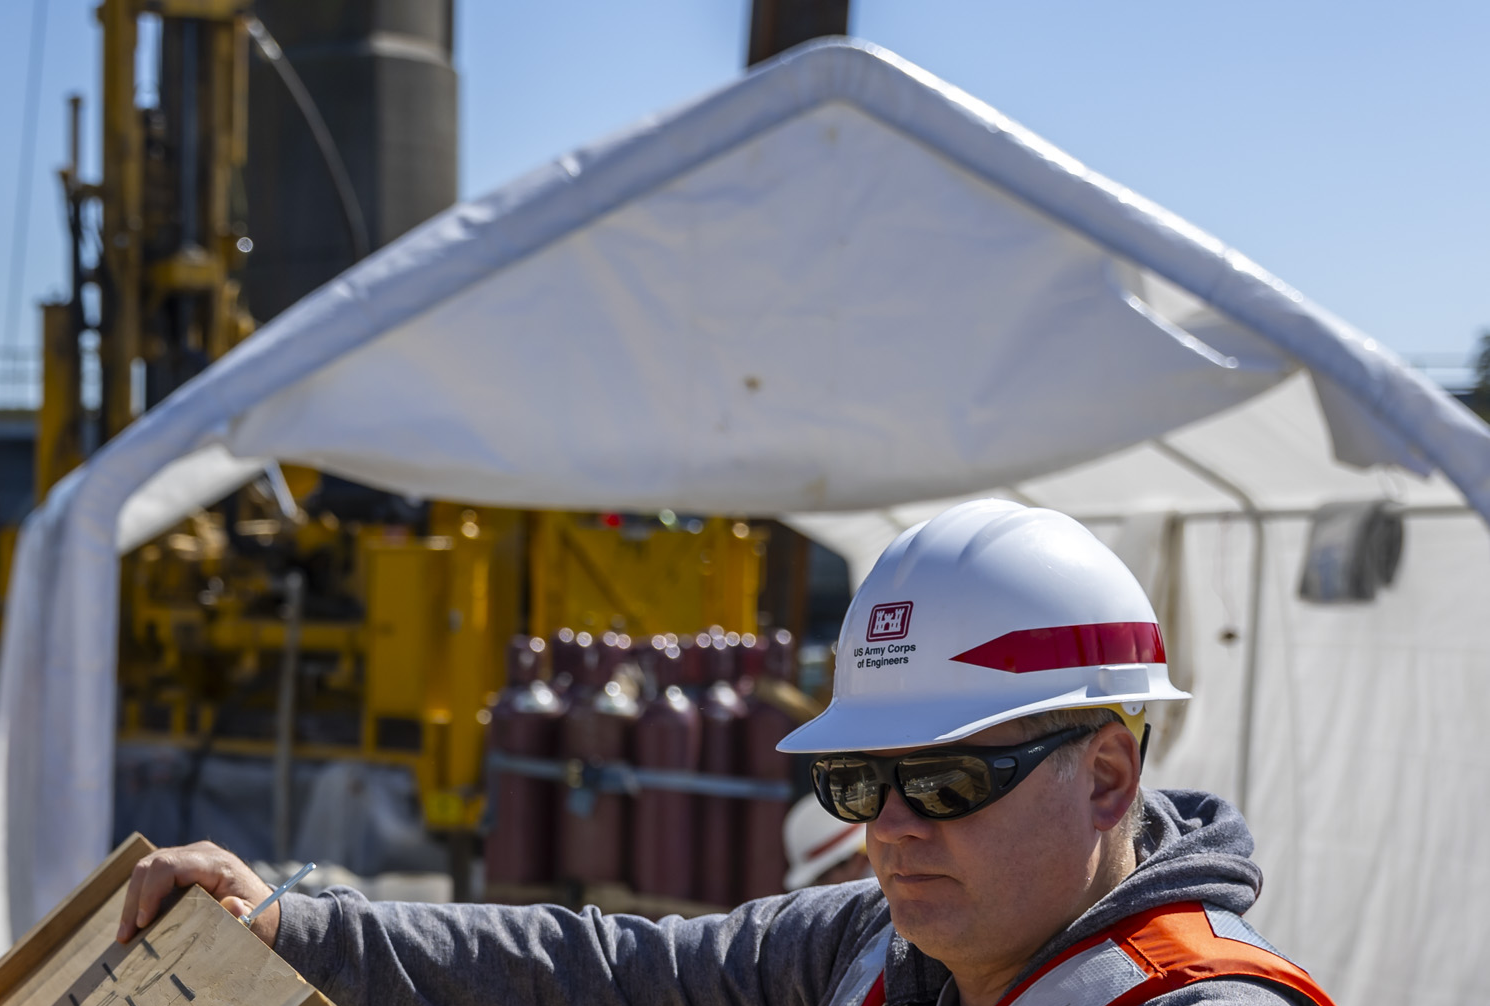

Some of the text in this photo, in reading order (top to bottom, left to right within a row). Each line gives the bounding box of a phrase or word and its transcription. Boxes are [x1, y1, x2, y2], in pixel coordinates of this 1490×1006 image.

[854, 644, 916, 657] US Army Corps
[857, 656, 909, 669] of Engineers
